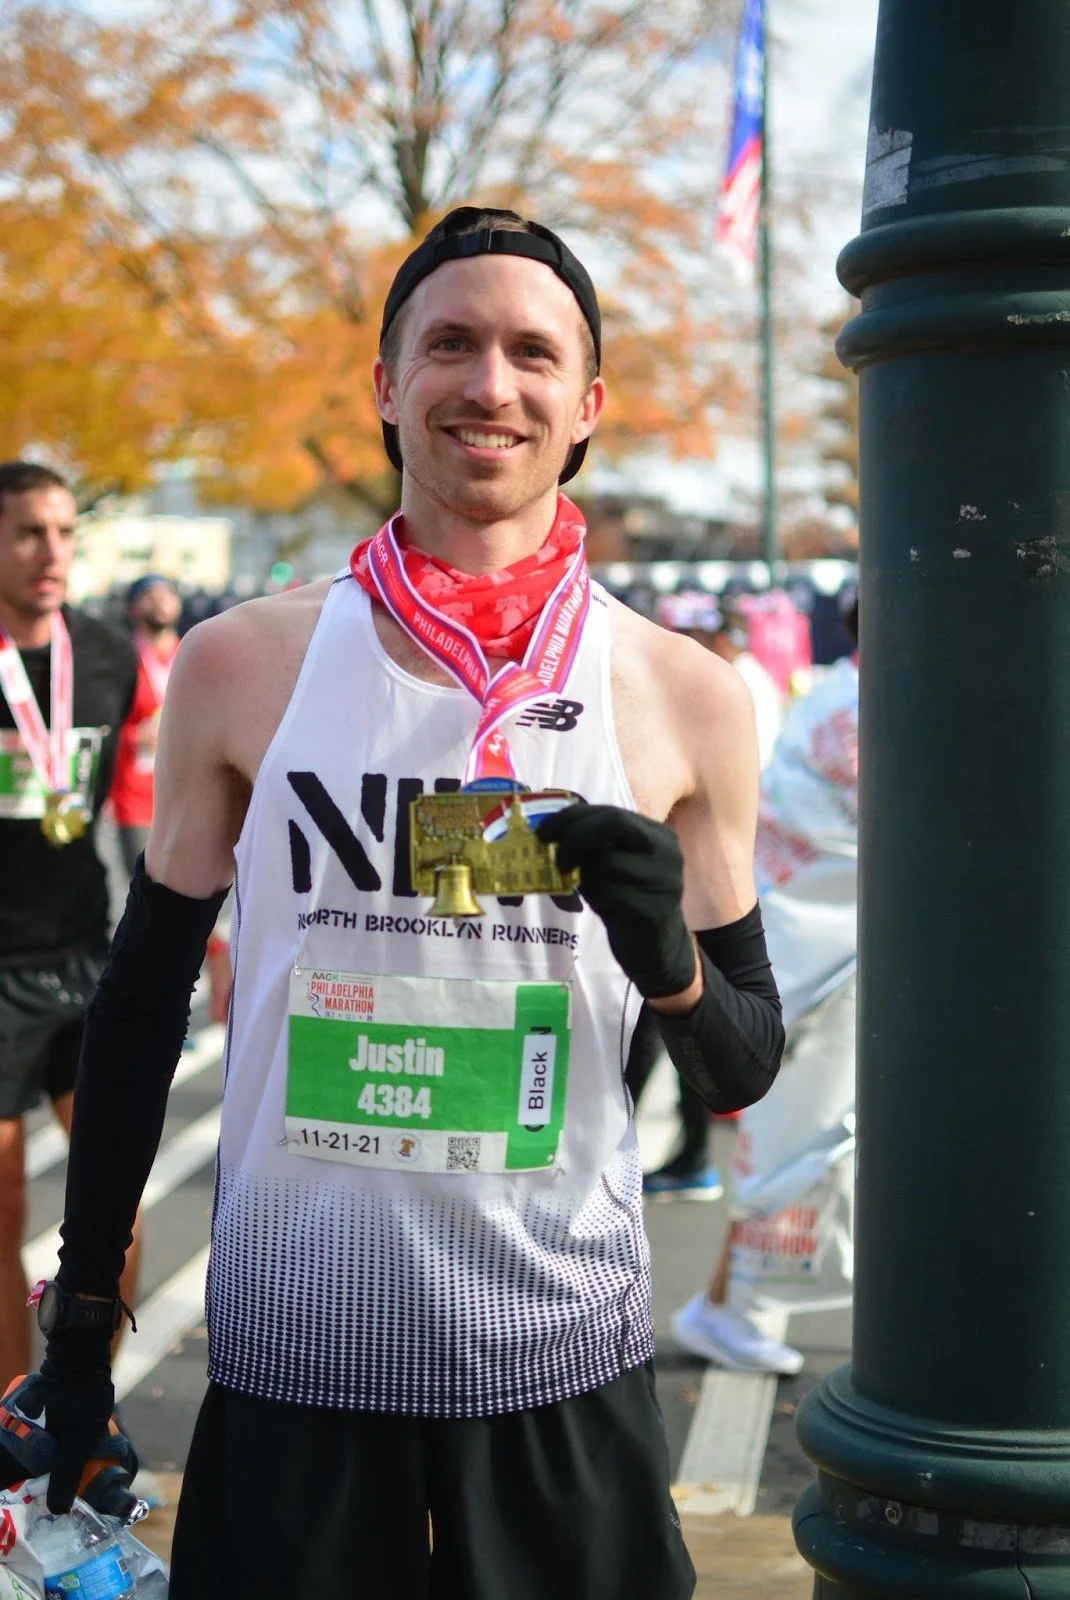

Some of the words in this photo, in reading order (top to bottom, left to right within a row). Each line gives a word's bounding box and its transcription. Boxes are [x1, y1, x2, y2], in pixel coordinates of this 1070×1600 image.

[412, 611, 480, 683] PHILADELPHIA
[298, 908, 356, 931] NORTH
[365, 914, 482, 940] BROOKLYN
[492, 924, 579, 950] RUNNERS
[310, 981, 375, 999] PHILADELPHIA
[324, 997, 374, 1014] MARATHON
[349, 1035, 445, 1076] Justin
[528, 1051, 548, 1110] Black
[356, 1083, 432, 1119] 4384
[300, 1128, 380, 1154] 11-21-21
